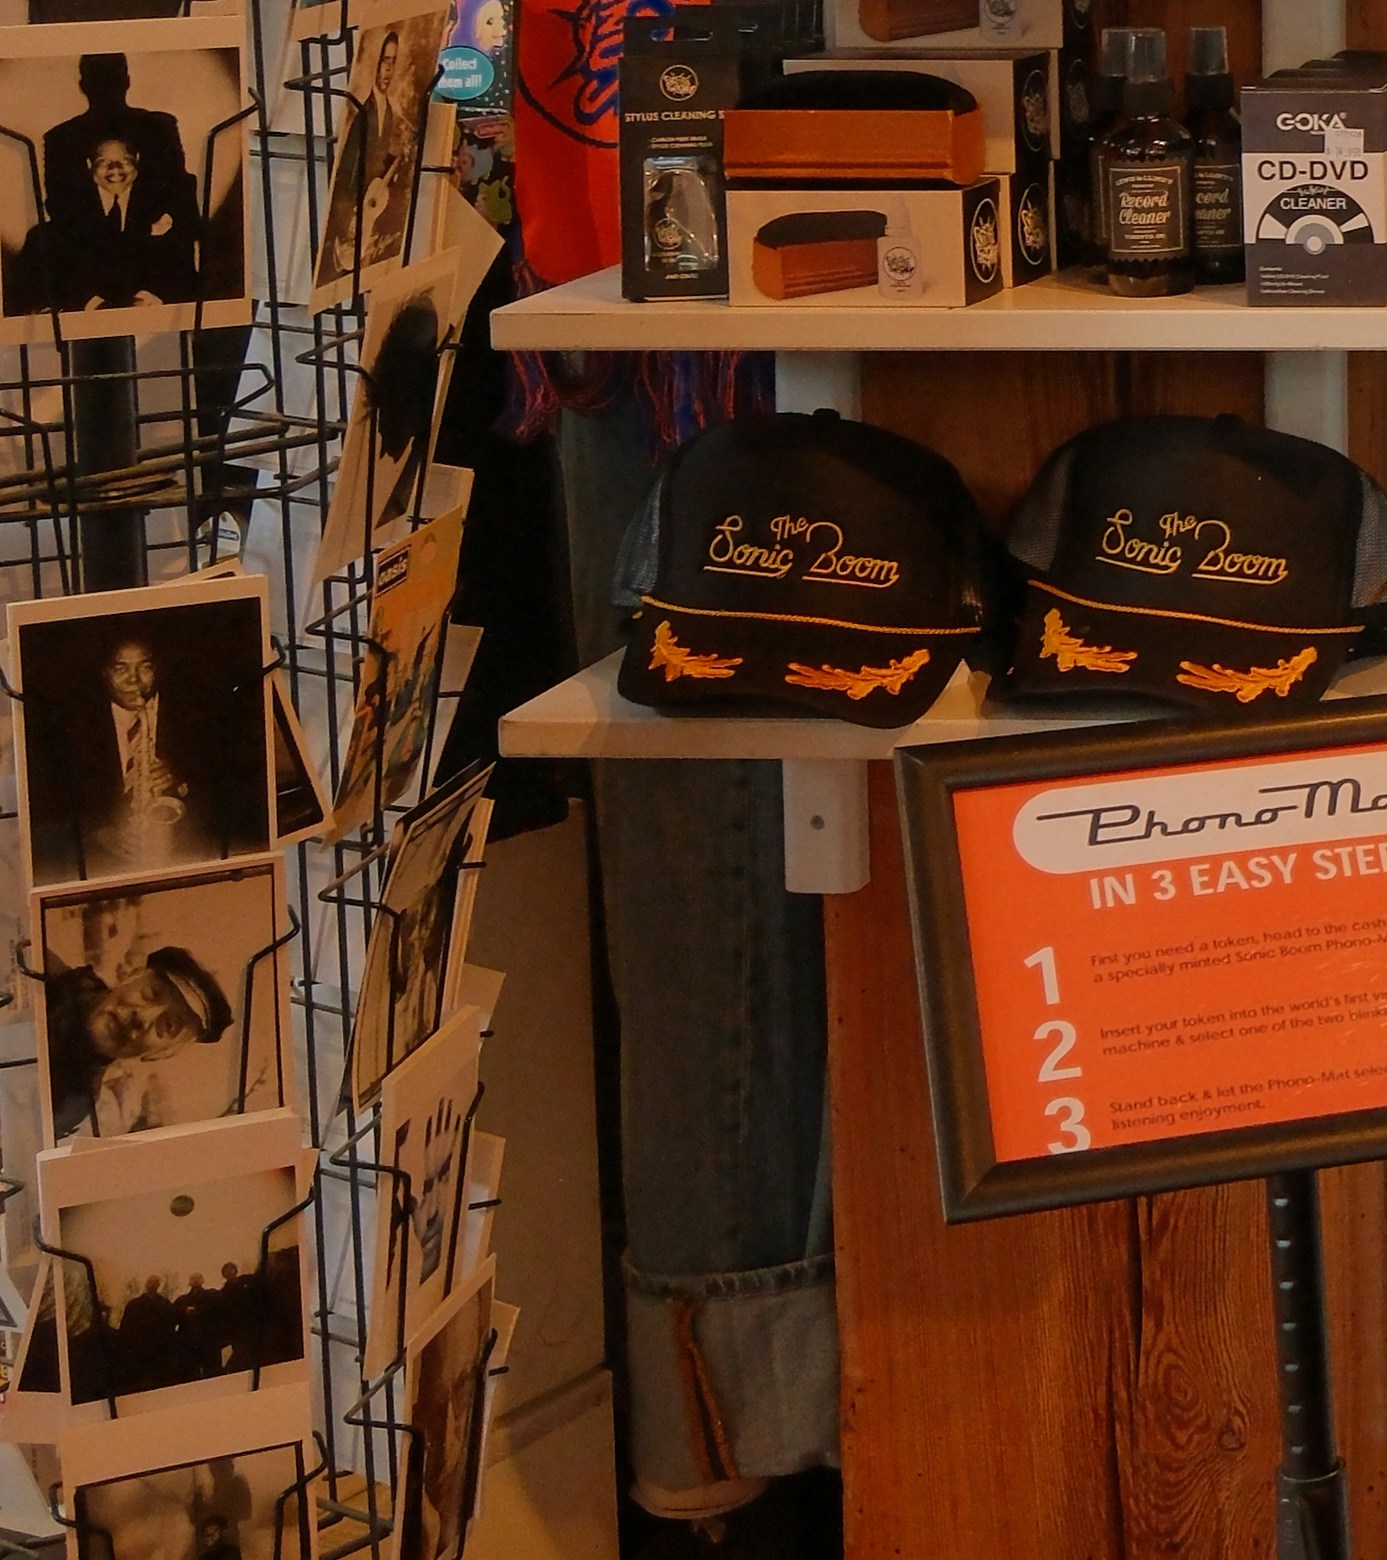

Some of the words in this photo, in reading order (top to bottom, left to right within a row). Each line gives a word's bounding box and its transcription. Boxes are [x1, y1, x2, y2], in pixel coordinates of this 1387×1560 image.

[624, 112, 659, 122] STYLUS
[661, 110, 716, 120] CLEANING
[1257, 160, 1368, 181] CD-DVD
[1118, 191, 1169, 208] Record
[1118, 208, 1171, 225] Cleaner
[1280, 197, 1347, 210] CLEANER
[771, 515, 809, 542] The
[1099, 509, 1182, 571] Sonic
[1195, 520, 1288, 581] Boom
[1160, 511, 1197, 537] The
[706, 515, 796, 574] Sonic
[805, 522, 899, 584] Boom
[1090, 874, 1136, 909] IN
[1151, 870, 1176, 901] 3
[1190, 852, 1297, 896] EASY
[1091, 954, 1118, 967] First
[1124, 951, 1151, 965] you
[1155, 942, 1195, 957] need
[1213, 936, 1259, 950] token,
[1263, 928, 1301, 942] head
[1306, 926, 1321, 937] to
[1325, 922, 1347, 935] the
[1352, 914, 1387, 931] cash
[1024, 946, 1060, 1005] 1
[1108, 962, 1174, 983] specially
[1179, 951, 1230, 971] minted
[1236, 947, 1276, 963] Sonic
[1279, 942, 1322, 957] Boom
[1100, 1024, 1142, 1040] Insert
[1146, 1019, 1178, 1036] your
[1183, 1012, 1225, 1028] token
[1230, 1007, 1257, 1021] into
[1261, 1003, 1285, 1016] the
[1289, 996, 1341, 1012] world's
[1344, 992, 1368, 1006] first
[1103, 1037, 1170, 1056] machine
[1190, 1029, 1234, 1043] select
[1239, 1026, 1267, 1037] one
[1272, 1019, 1286, 1032] of
[1290, 1017, 1314, 1029] the
[1318, 1013, 1344, 1026] two
[1033, 1020, 1083, 1082] 2
[1110, 1098, 1153, 1114] Stand
[1158, 1091, 1198, 1106] back
[1217, 1086, 1235, 1098] let
[1239, 1083, 1263, 1095] the
[1268, 1071, 1349, 1091] Phono-Mat
[1044, 1096, 1092, 1155] 3
[1112, 1112, 1175, 1130] listening
[1180, 1099, 1265, 1120] enjoyment.
